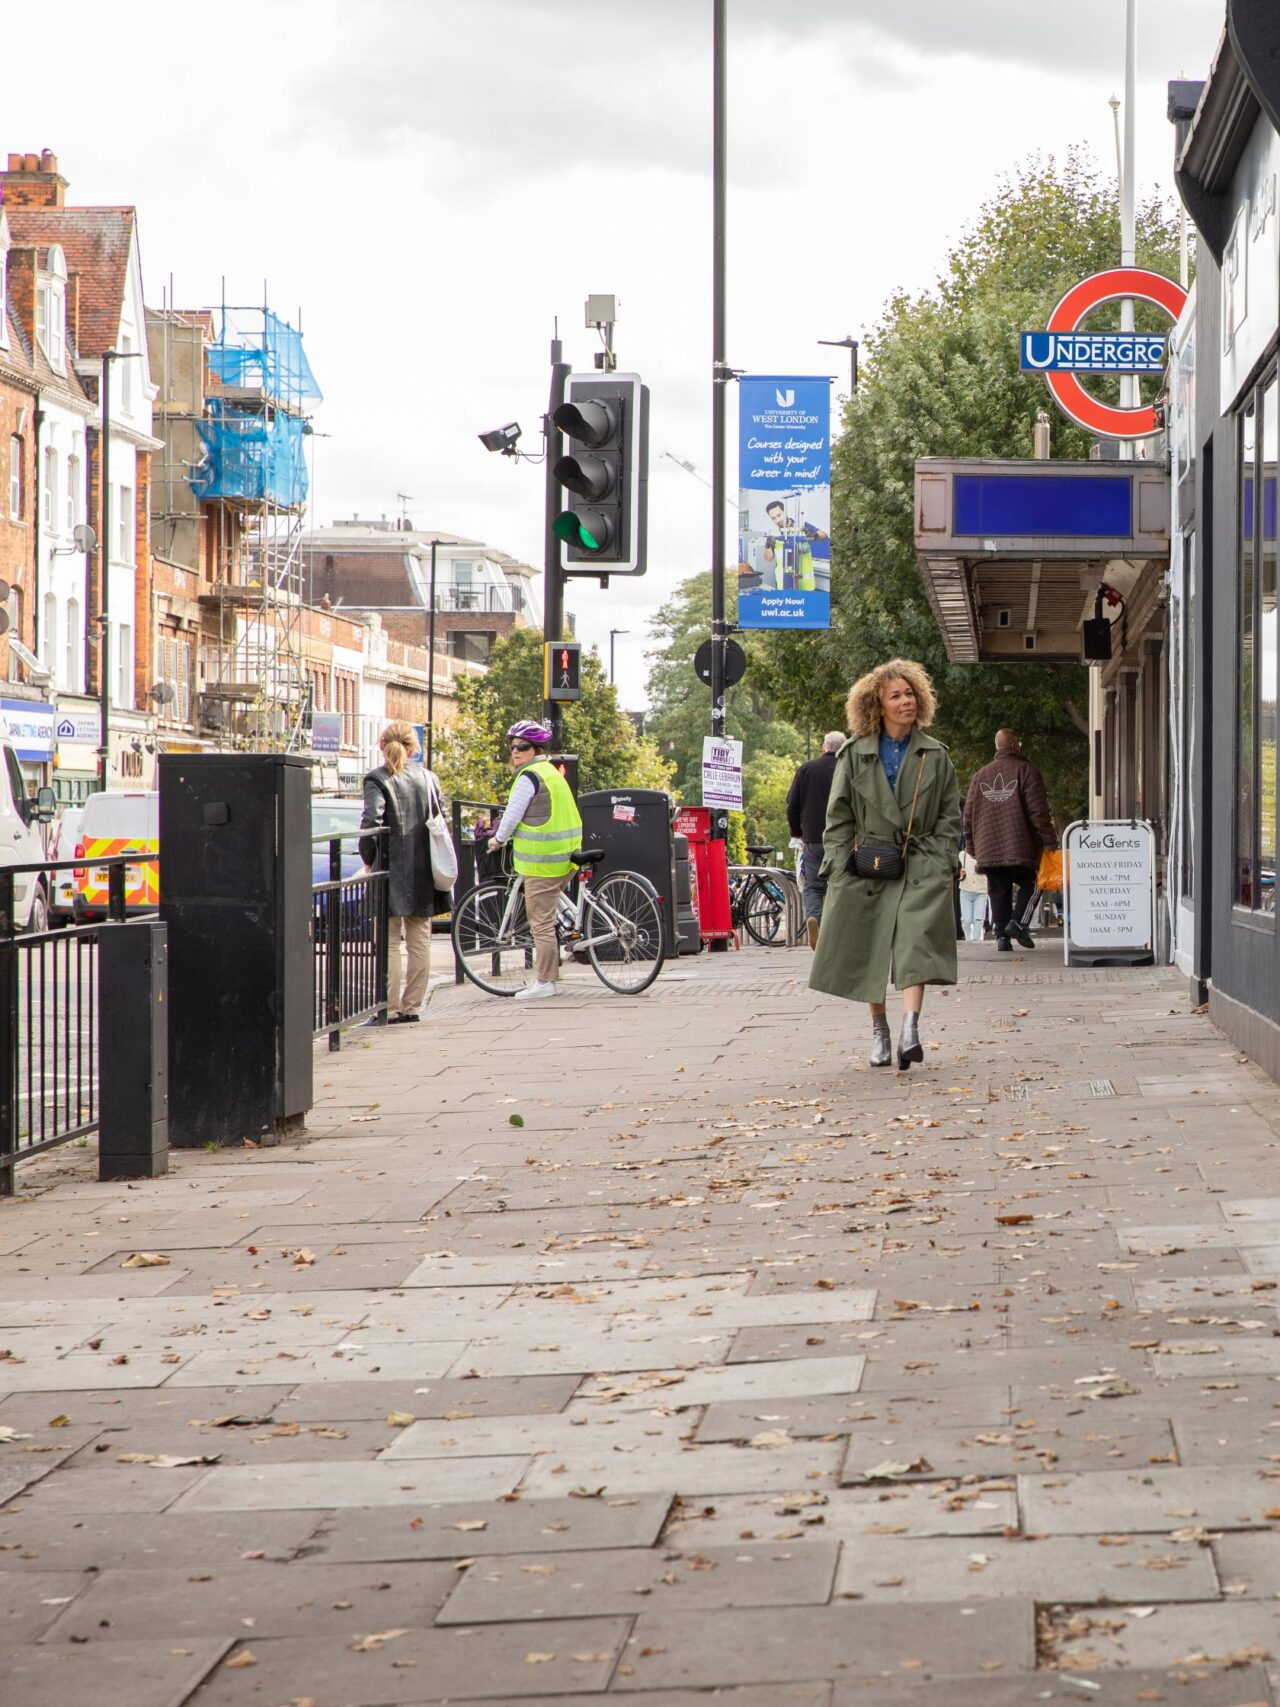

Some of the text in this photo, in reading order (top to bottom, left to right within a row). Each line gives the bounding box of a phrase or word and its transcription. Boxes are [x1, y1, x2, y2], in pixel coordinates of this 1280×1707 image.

[1026, 335, 1164, 368] UNDERGRO
[752, 415, 819, 424] WEST LONDON
[748, 437, 824, 454] Courses designed
[763, 451, 807, 468] with your
[751, 465, 820, 480] career in mind!
[761, 597, 805, 607] Apply Now!
[761, 608, 805, 618] uwl.ac.uk
[713, 748, 730, 757] TIDY
[1076, 861, 1143, 869] MONDAY-FRIDAY
[1088, 887, 1131, 895] SATURDAY
[1094, 913, 1127, 921] SUNDAY
[1089, 926, 1111, 934] 10AM
